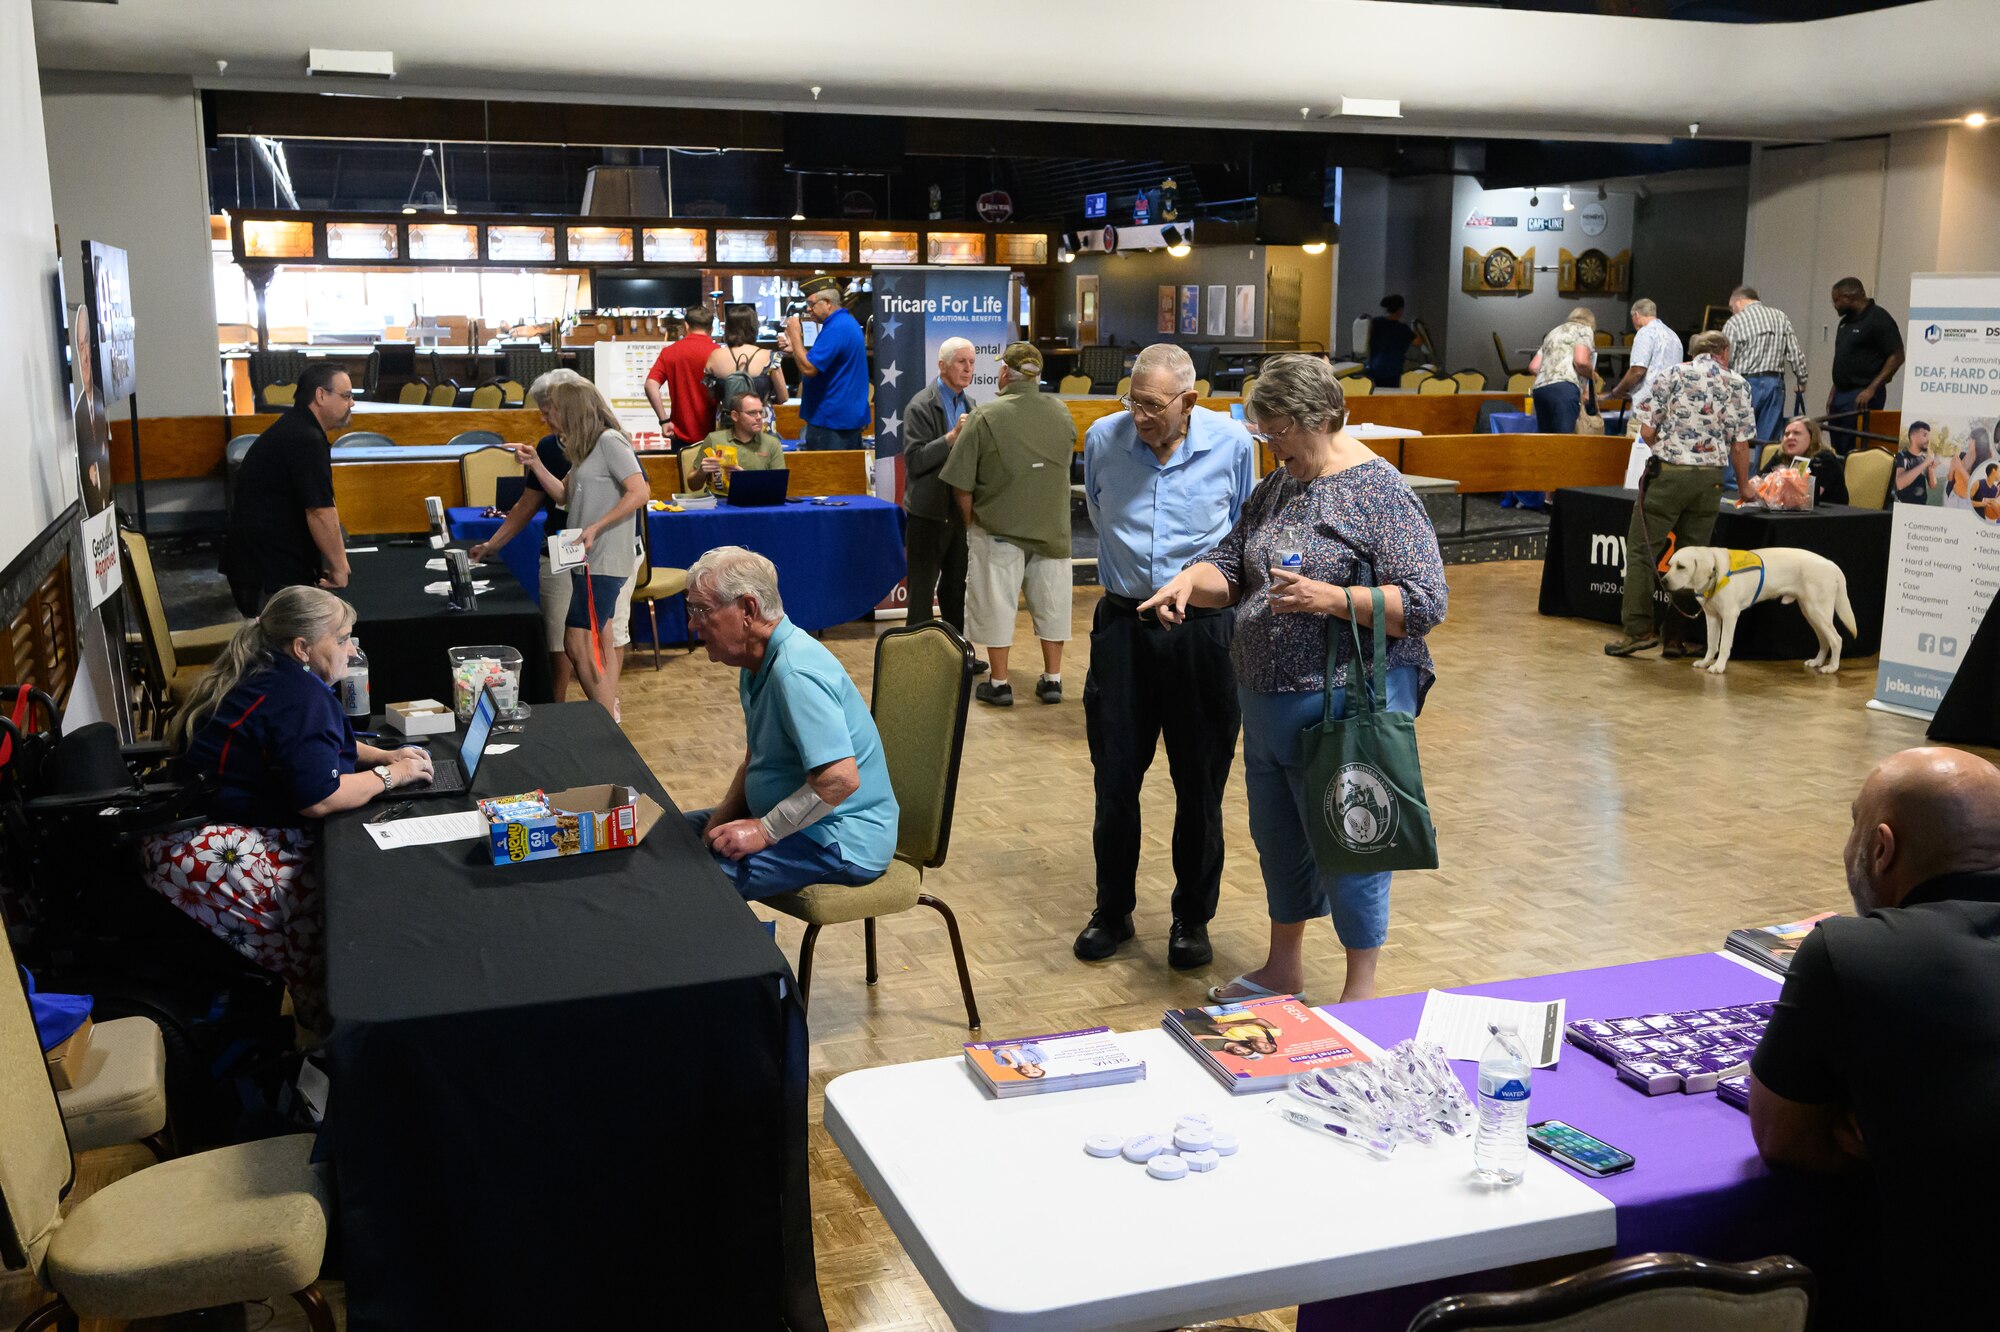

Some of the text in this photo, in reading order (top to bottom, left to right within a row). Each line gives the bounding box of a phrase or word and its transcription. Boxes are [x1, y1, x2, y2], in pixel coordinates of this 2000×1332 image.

[880, 295, 1002, 313] Tricare For Life
[975, 343, 1000, 355] ental
[1914, 366, 1947, 379] DEAF,
[1950, 367, 1985, 379] HARD
[1920, 381, 1988, 395] DEAFBLIND
[1908, 521, 1948, 534] Community
[1907, 532, 1943, 543] Education
[1906, 543, 1929, 553] Events
[1905, 557, 1923, 566] Hard
[1933, 561, 1962, 573] Hearing
[1904, 567, 1934, 578] Program
[890, 582, 908, 602] YO
[1902, 581, 1920, 590] Case
[1901, 592, 1949, 606] Management
[1900, 606, 1943, 620] Employment
[348, 680, 358, 709] pepsi
[508, 823, 526, 862] CHEWY
[530, 831, 542, 848] 60
[1282, 1004, 1310, 1023] GEHA
[1092, 1057, 1131, 1067] GEHA
[1290, 1048, 1350, 1062] Dental Plans
[1501, 1090, 1525, 1098] WATER
[1290, 1111, 1309, 1123] GEHA
